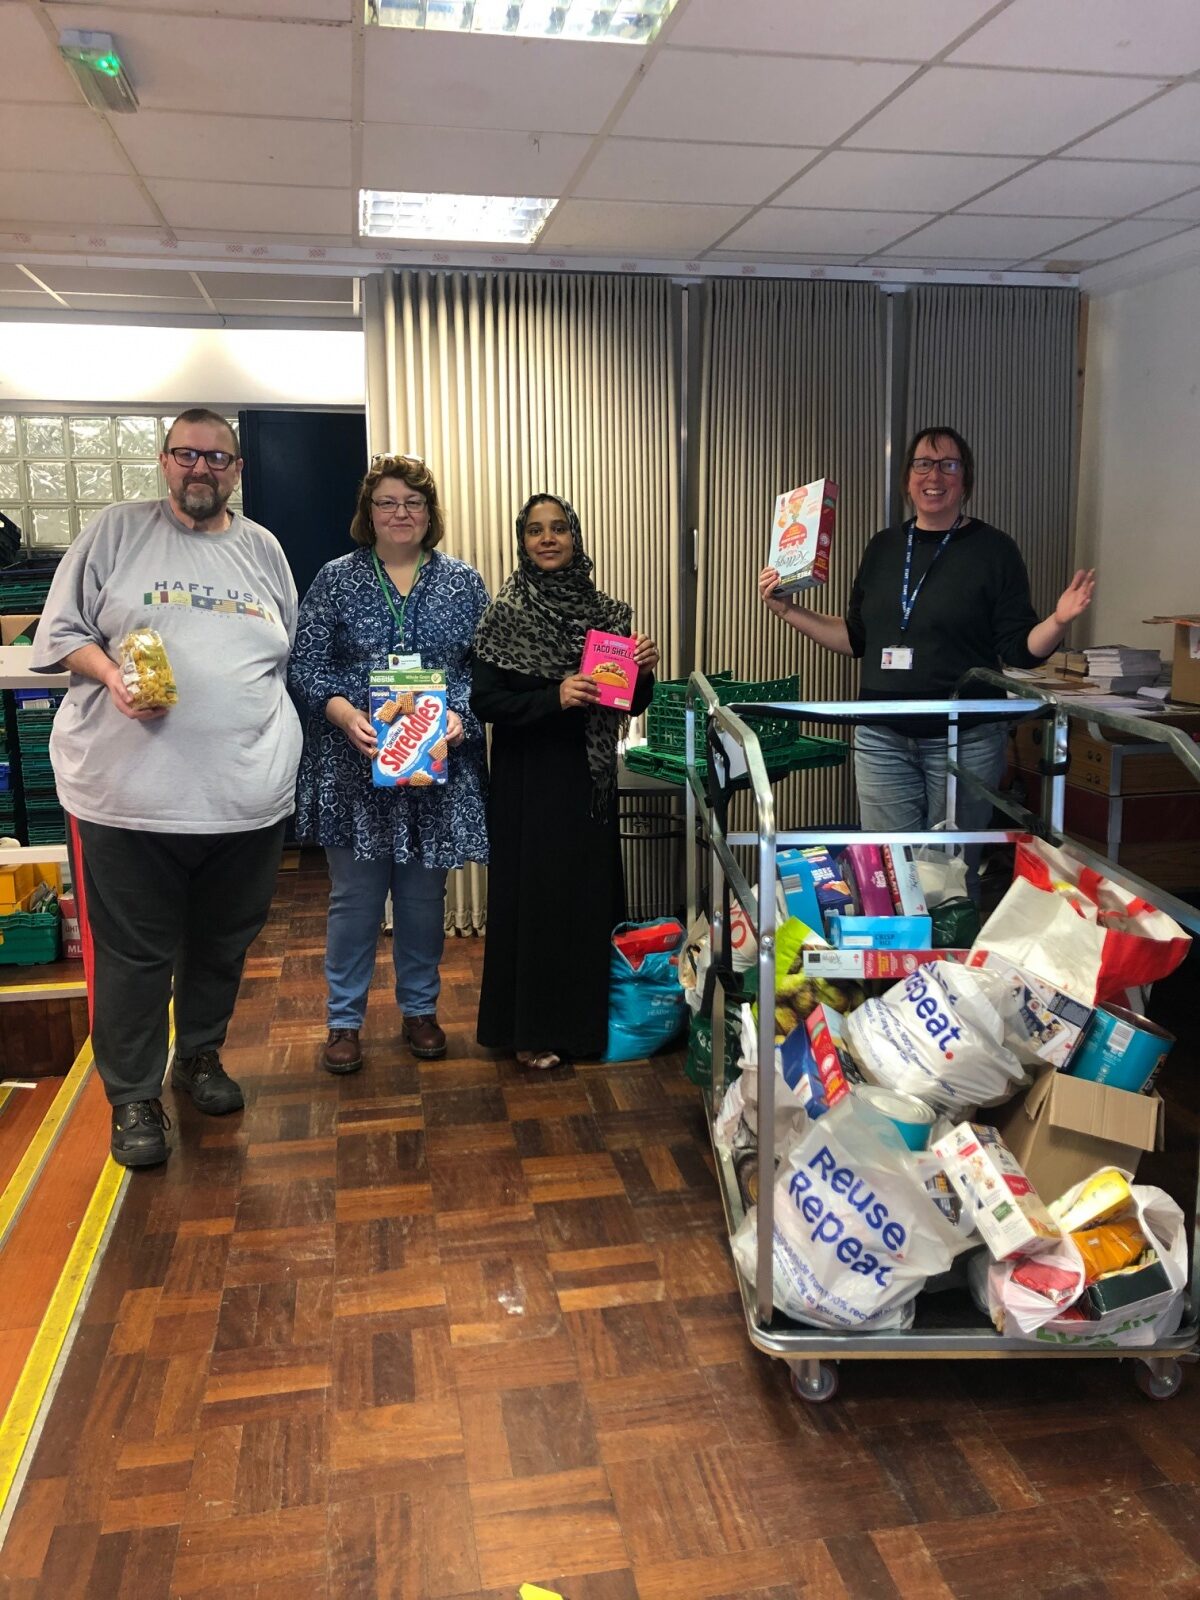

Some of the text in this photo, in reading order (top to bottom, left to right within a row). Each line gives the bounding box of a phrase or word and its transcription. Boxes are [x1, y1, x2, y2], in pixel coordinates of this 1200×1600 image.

[154, 580, 214, 596] HAFT
[593, 644, 610, 654] TACO
[380, 698, 440, 772] Shreddies
